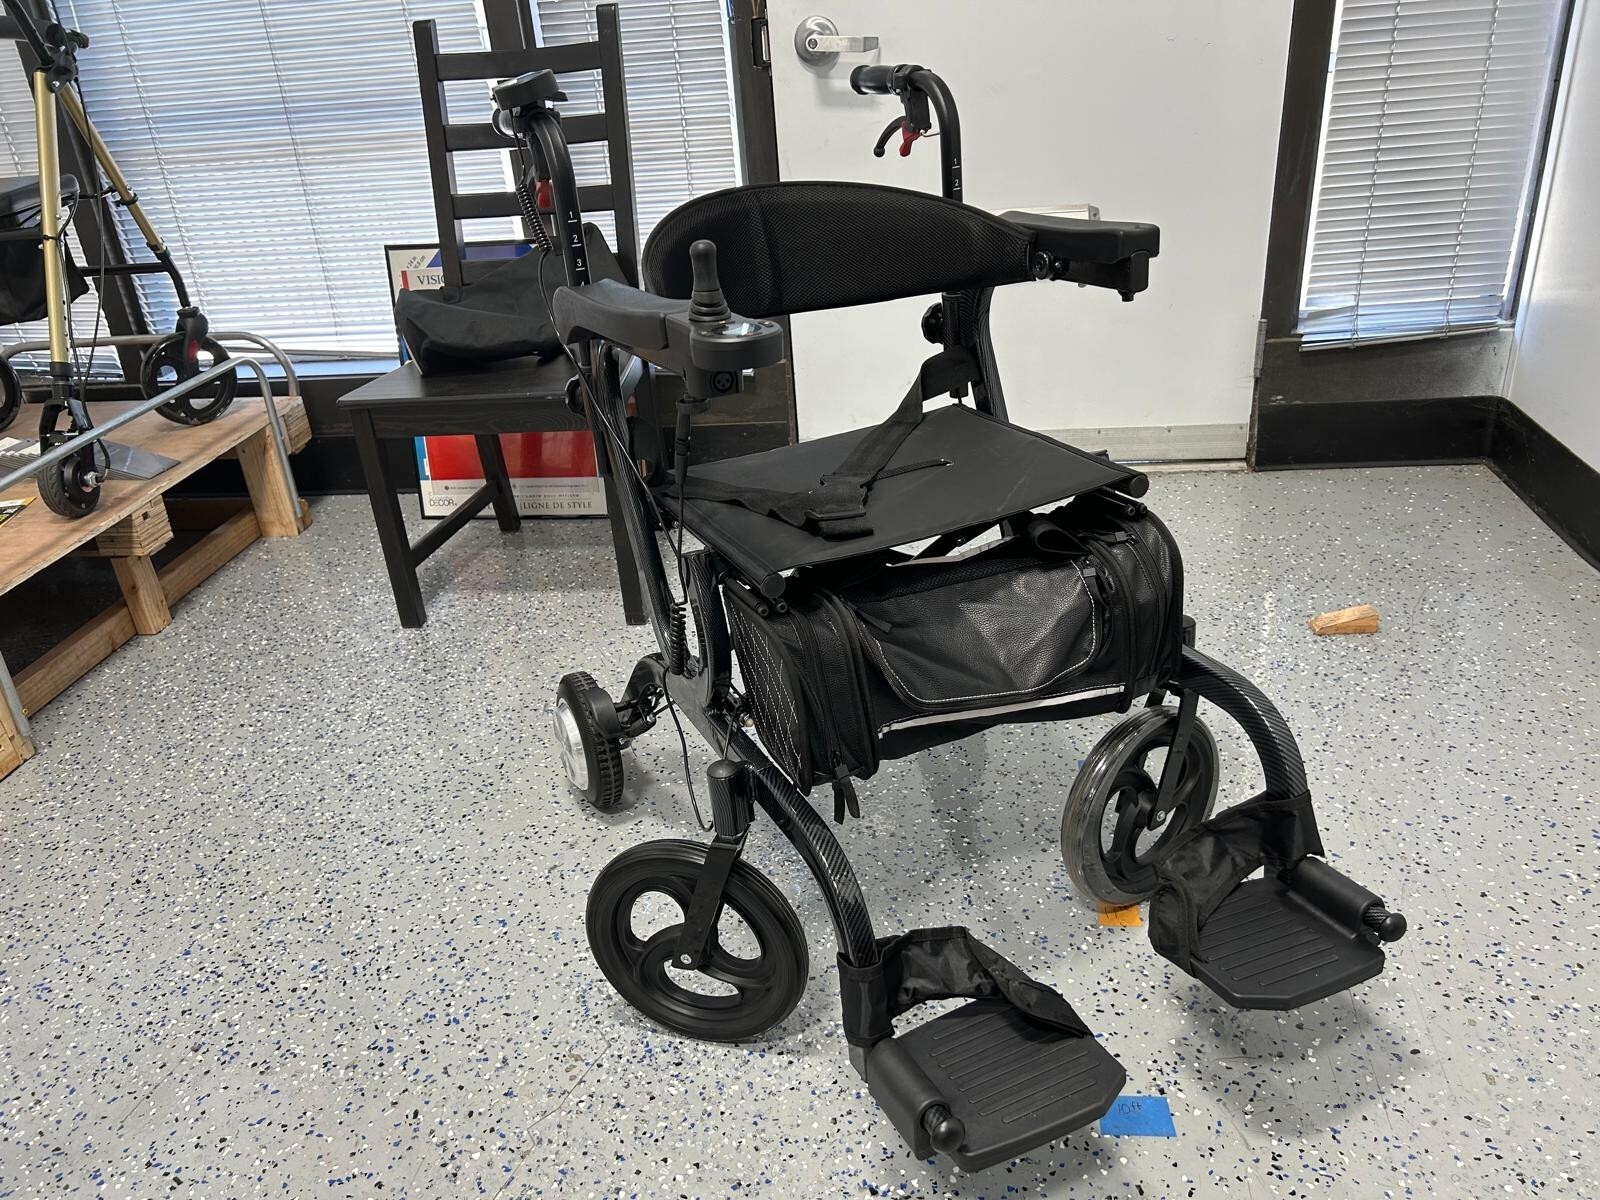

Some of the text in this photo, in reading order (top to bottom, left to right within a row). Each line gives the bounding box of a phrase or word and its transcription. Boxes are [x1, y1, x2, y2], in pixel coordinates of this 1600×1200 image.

[573, 234, 579, 242] 2
[523, 501, 592, 510] LIGNE DE STYLE
